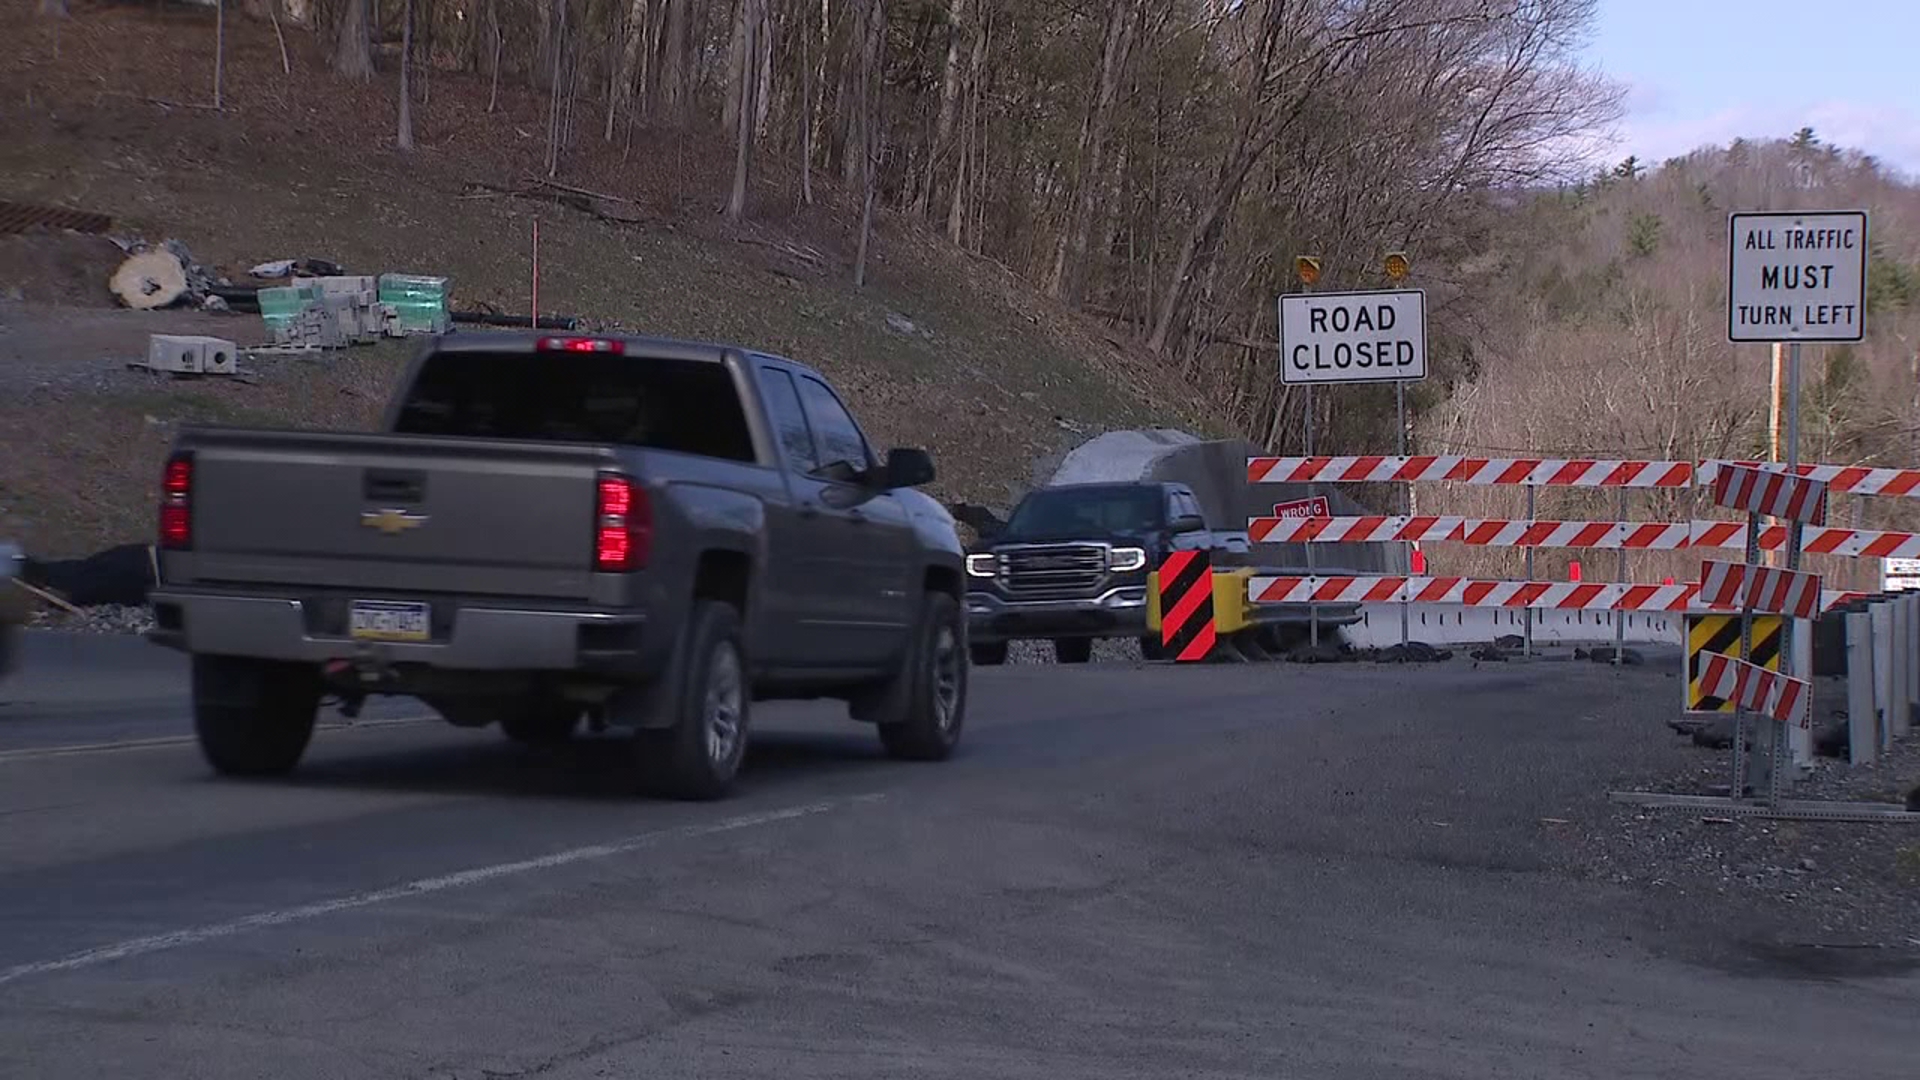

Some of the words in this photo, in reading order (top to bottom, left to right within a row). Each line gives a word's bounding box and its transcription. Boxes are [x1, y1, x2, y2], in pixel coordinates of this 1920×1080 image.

[1745, 229, 1776, 251] ALL
[1785, 228, 1854, 251] TRAFFIC
[1761, 264, 1835, 291] MUST
[1310, 304, 1396, 334] ROAD
[1738, 304, 1792, 326] TURN
[1805, 304, 1856, 326] LEFT
[1292, 339, 1415, 371] CLOSED
